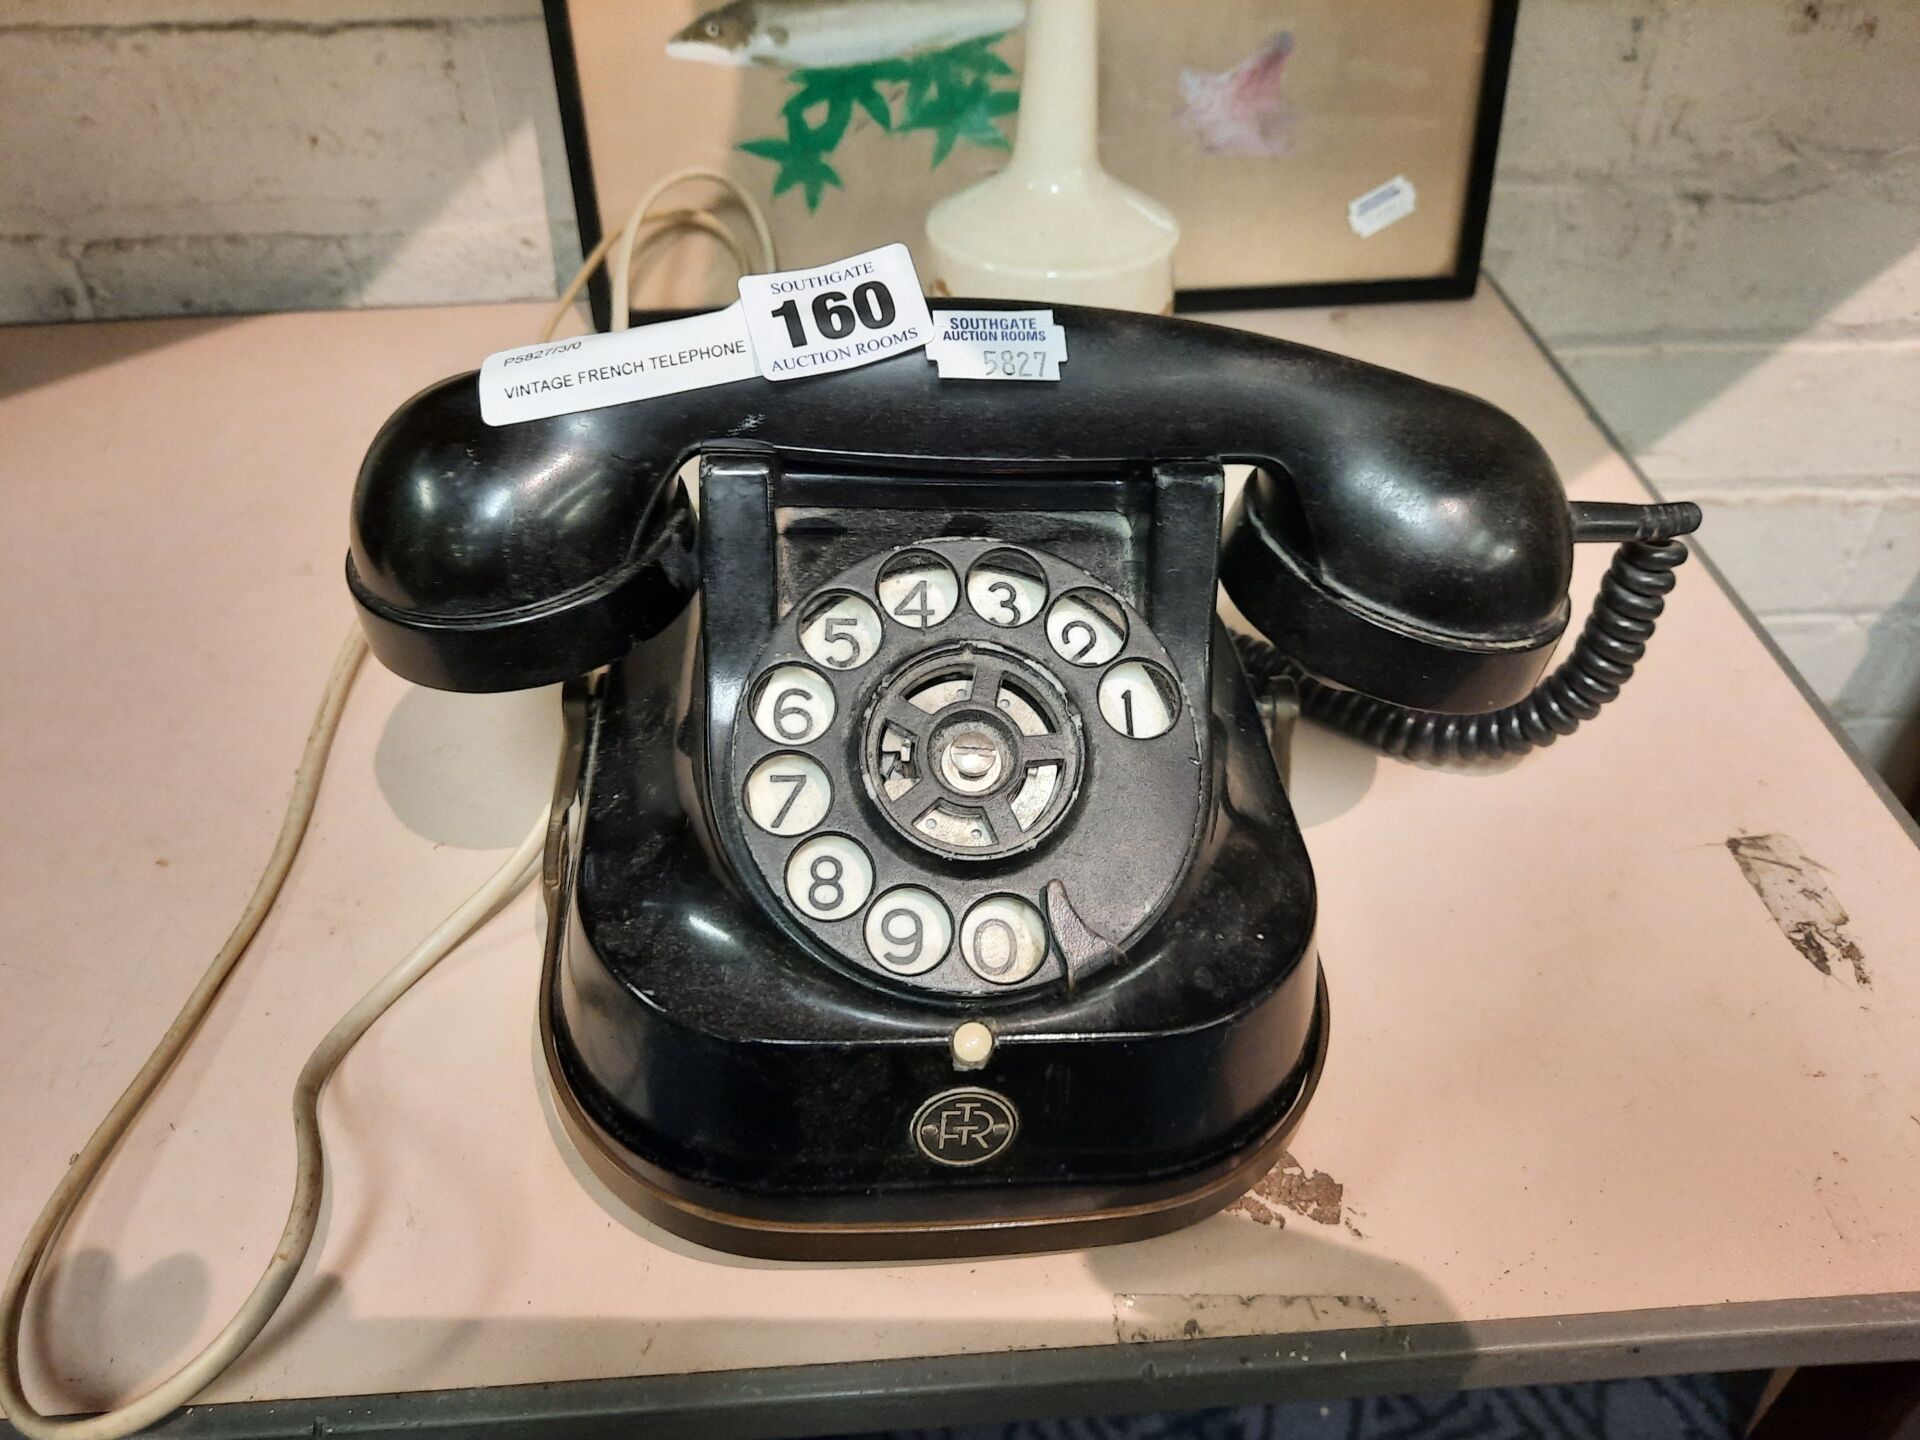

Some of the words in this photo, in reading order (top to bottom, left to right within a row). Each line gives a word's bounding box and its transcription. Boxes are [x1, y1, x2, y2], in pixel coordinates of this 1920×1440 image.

[770, 261, 875, 295] SOUTHGATE
[771, 280, 896, 348] 160
[943, 330, 998, 341] AUCTION
[1001, 330, 1046, 341] ROOMS
[950, 317, 1037, 330] SOUTHGATE
[503, 341, 582, 367] P5827/3/0
[504, 374, 573, 399] VINTAGE
[577, 360, 645, 384] FRENCH
[649, 340, 746, 371] TELEPHONE
[771, 347, 853, 372] AUCTION
[857, 327, 918, 356] ROOMS
[983, 349, 1047, 377] 5827
[894, 580, 935, 629] 4
[988, 582, 1021, 627] 3
[824, 618, 860, 668] 5
[1061, 620, 1098, 666] 2
[773, 688, 813, 740] 6
[1121, 689, 1135, 737] 1
[769, 774, 807, 828] 7
[808, 855, 844, 911] 8
[881, 907, 924, 965] 9
[973, 918, 1018, 976] 0
